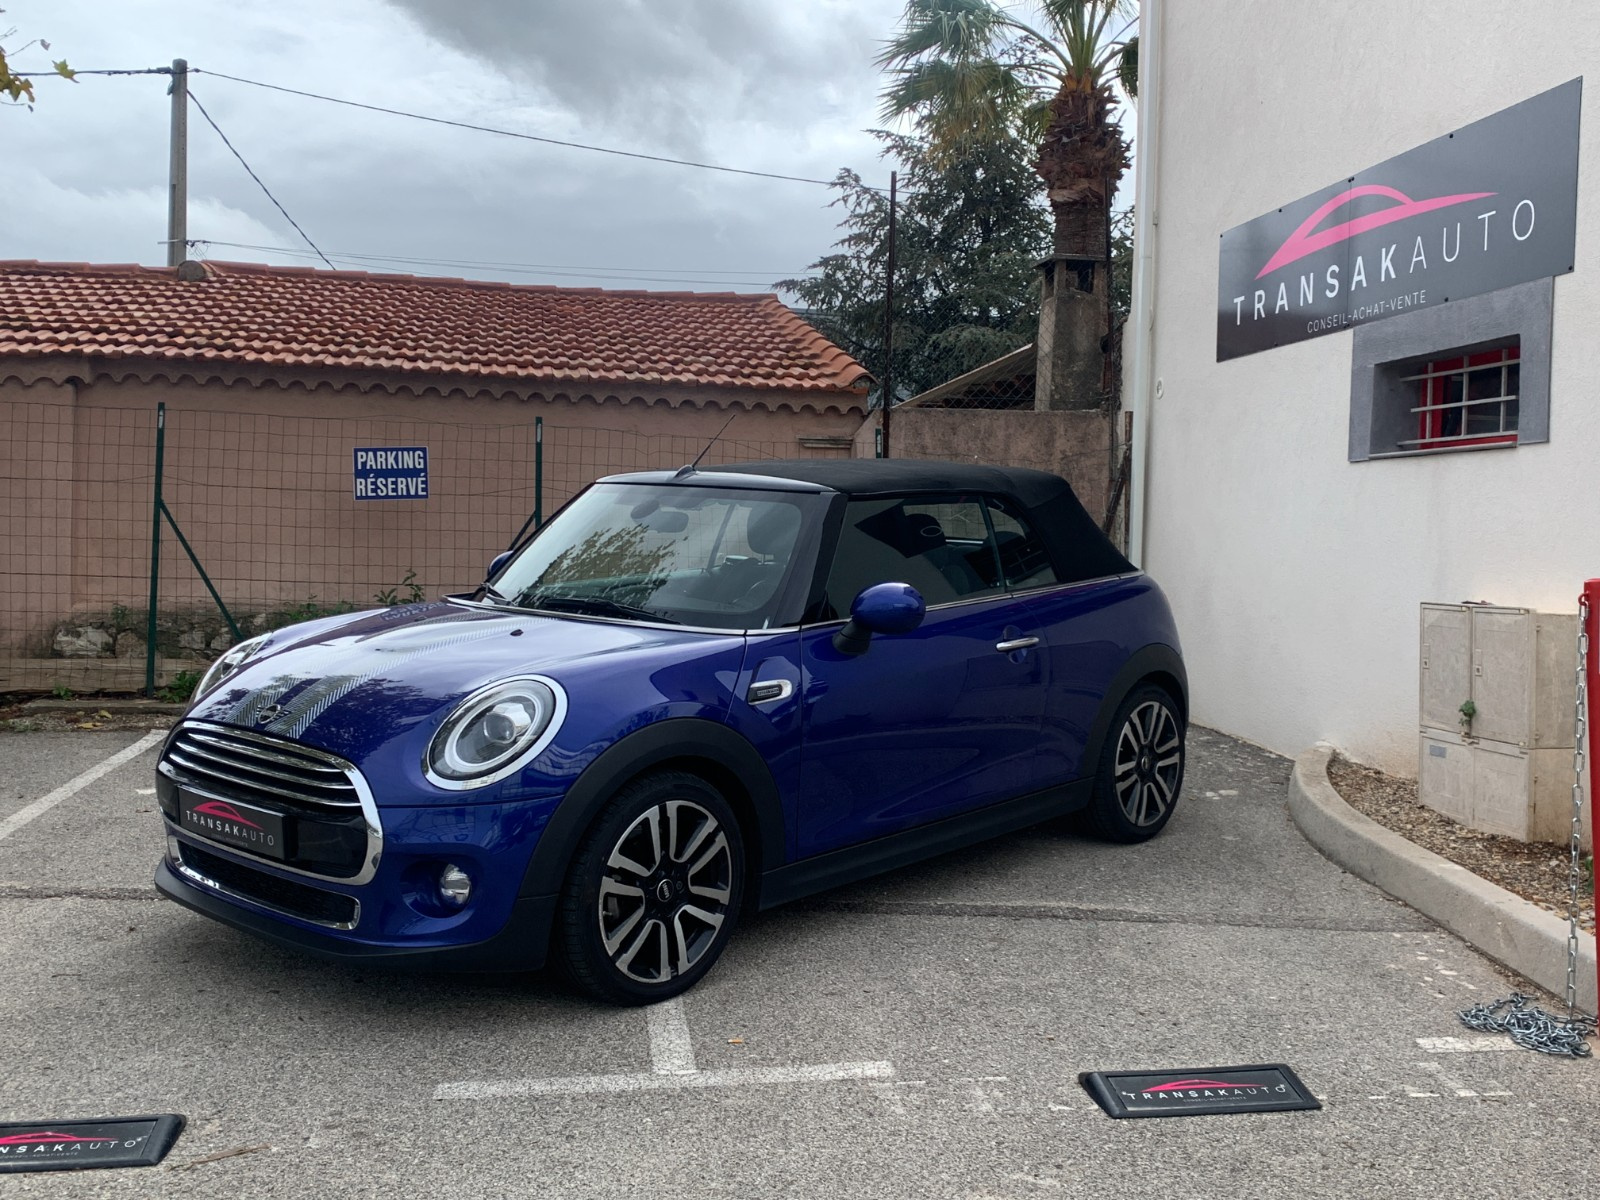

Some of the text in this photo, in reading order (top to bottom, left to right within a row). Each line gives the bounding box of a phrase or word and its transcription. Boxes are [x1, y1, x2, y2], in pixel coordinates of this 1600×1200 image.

[1233, 199, 1535, 326] TRANSAKAUTO
[1307, 289, 1427, 334] CONSEIL-ACHAT-VENTE
[357, 450, 425, 470] PARKING
[356, 472, 427, 496] RÉSERVÉ
[186, 810, 275, 847] TRANSAKAUTO
[1126, 1085, 1286, 1100] TRANSAKAUTO
